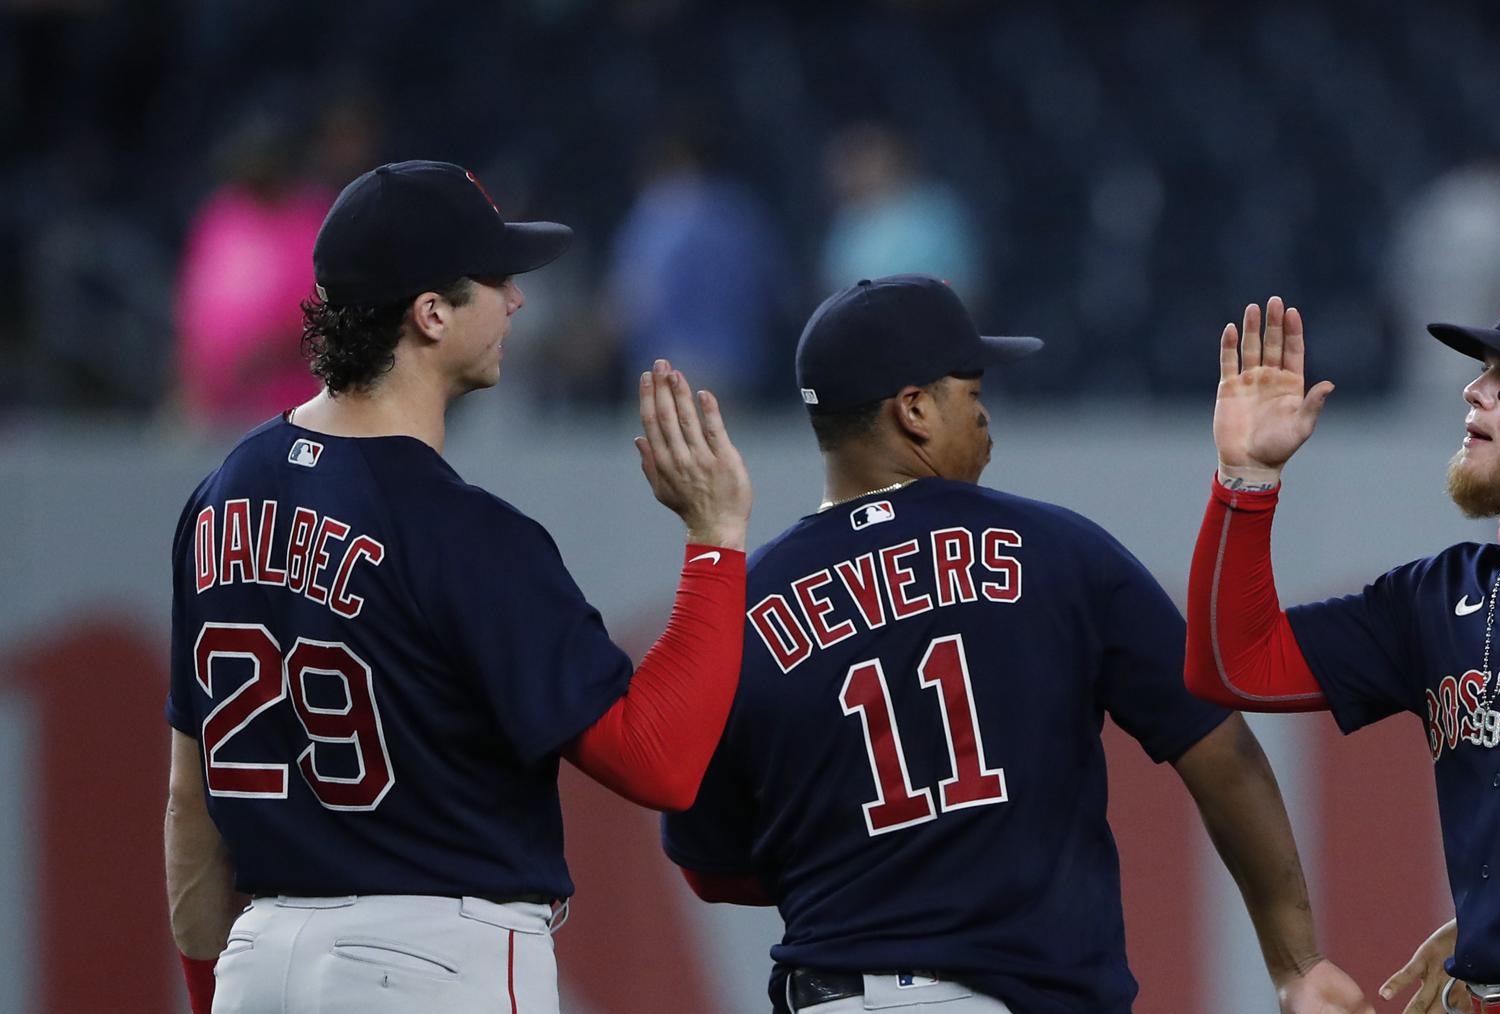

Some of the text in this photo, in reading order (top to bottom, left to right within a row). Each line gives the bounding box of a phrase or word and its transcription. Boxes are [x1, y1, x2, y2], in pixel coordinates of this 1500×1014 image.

[194, 498, 385, 619] DALBEC
[746, 526, 1023, 674] DEVERS
[194, 621, 396, 812] 29
[839, 633, 1009, 837] 11
